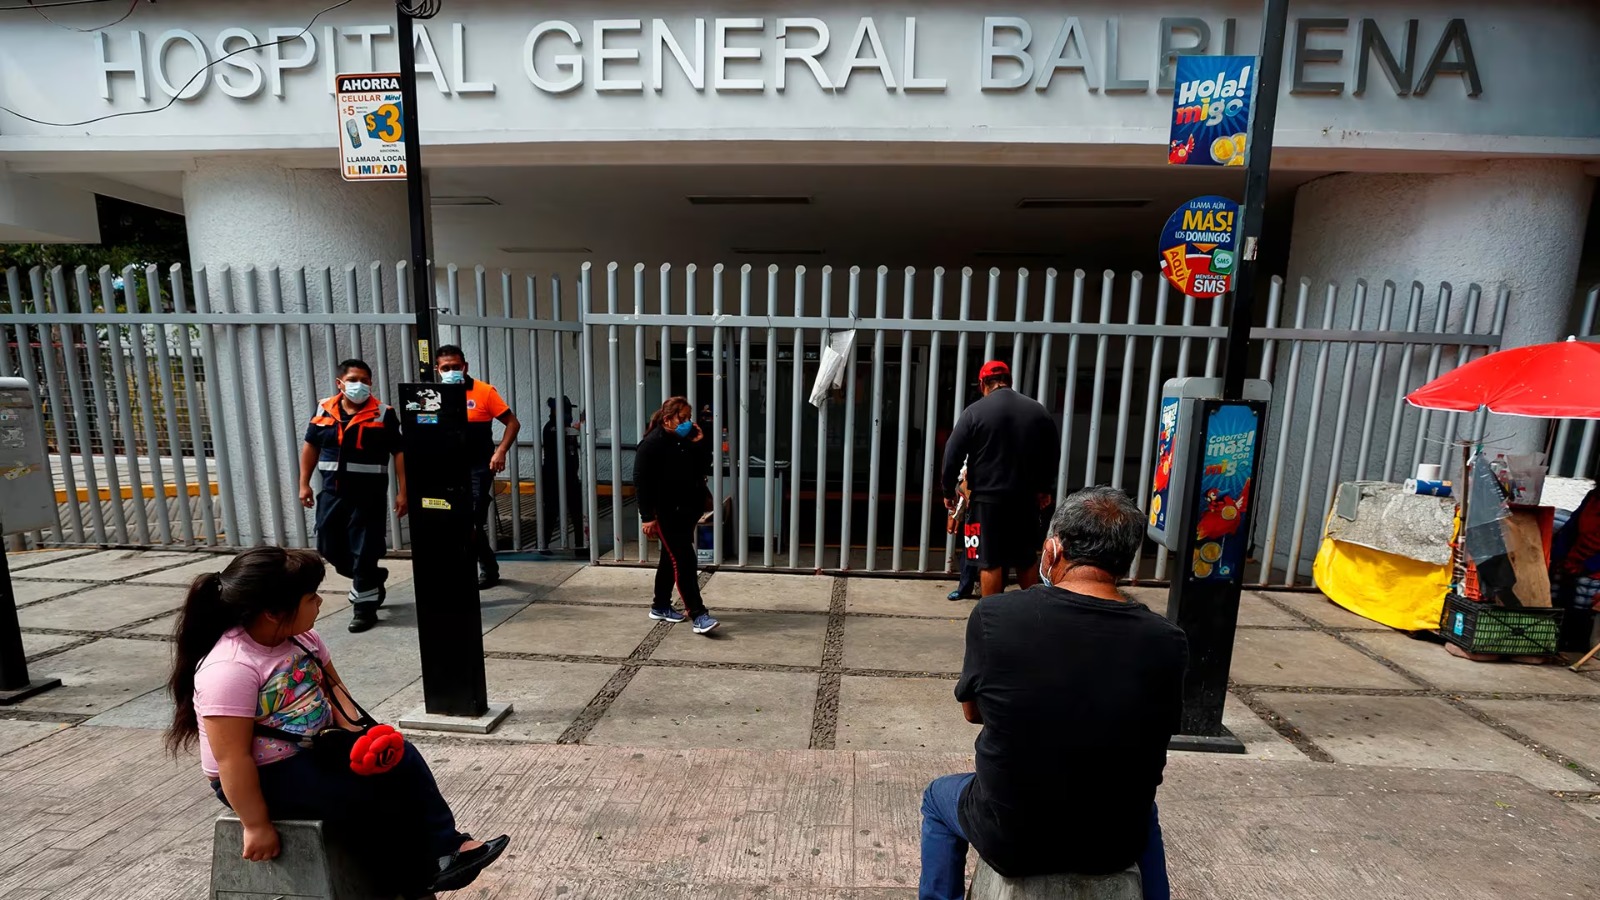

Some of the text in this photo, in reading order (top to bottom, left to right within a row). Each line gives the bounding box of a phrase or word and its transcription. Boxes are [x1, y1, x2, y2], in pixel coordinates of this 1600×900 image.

[95, 16, 1483, 101] HOSPITAL GENERAL BALBENA
[342, 78, 400, 91] AHORRA
[1178, 65, 1251, 105] Hola!
[1175, 97, 1244, 126] migo
[347, 164, 407, 175] ILIMITADA
[1190, 200, 1226, 210] LLAMA AÚN
[1182, 209, 1234, 232] MÁS!
[1174, 231, 1231, 243] LOS DOMINGOS
[1216, 257, 1230, 265] SMS
[1193, 279, 1226, 294] SMS
[1205, 459, 1249, 477] migo
